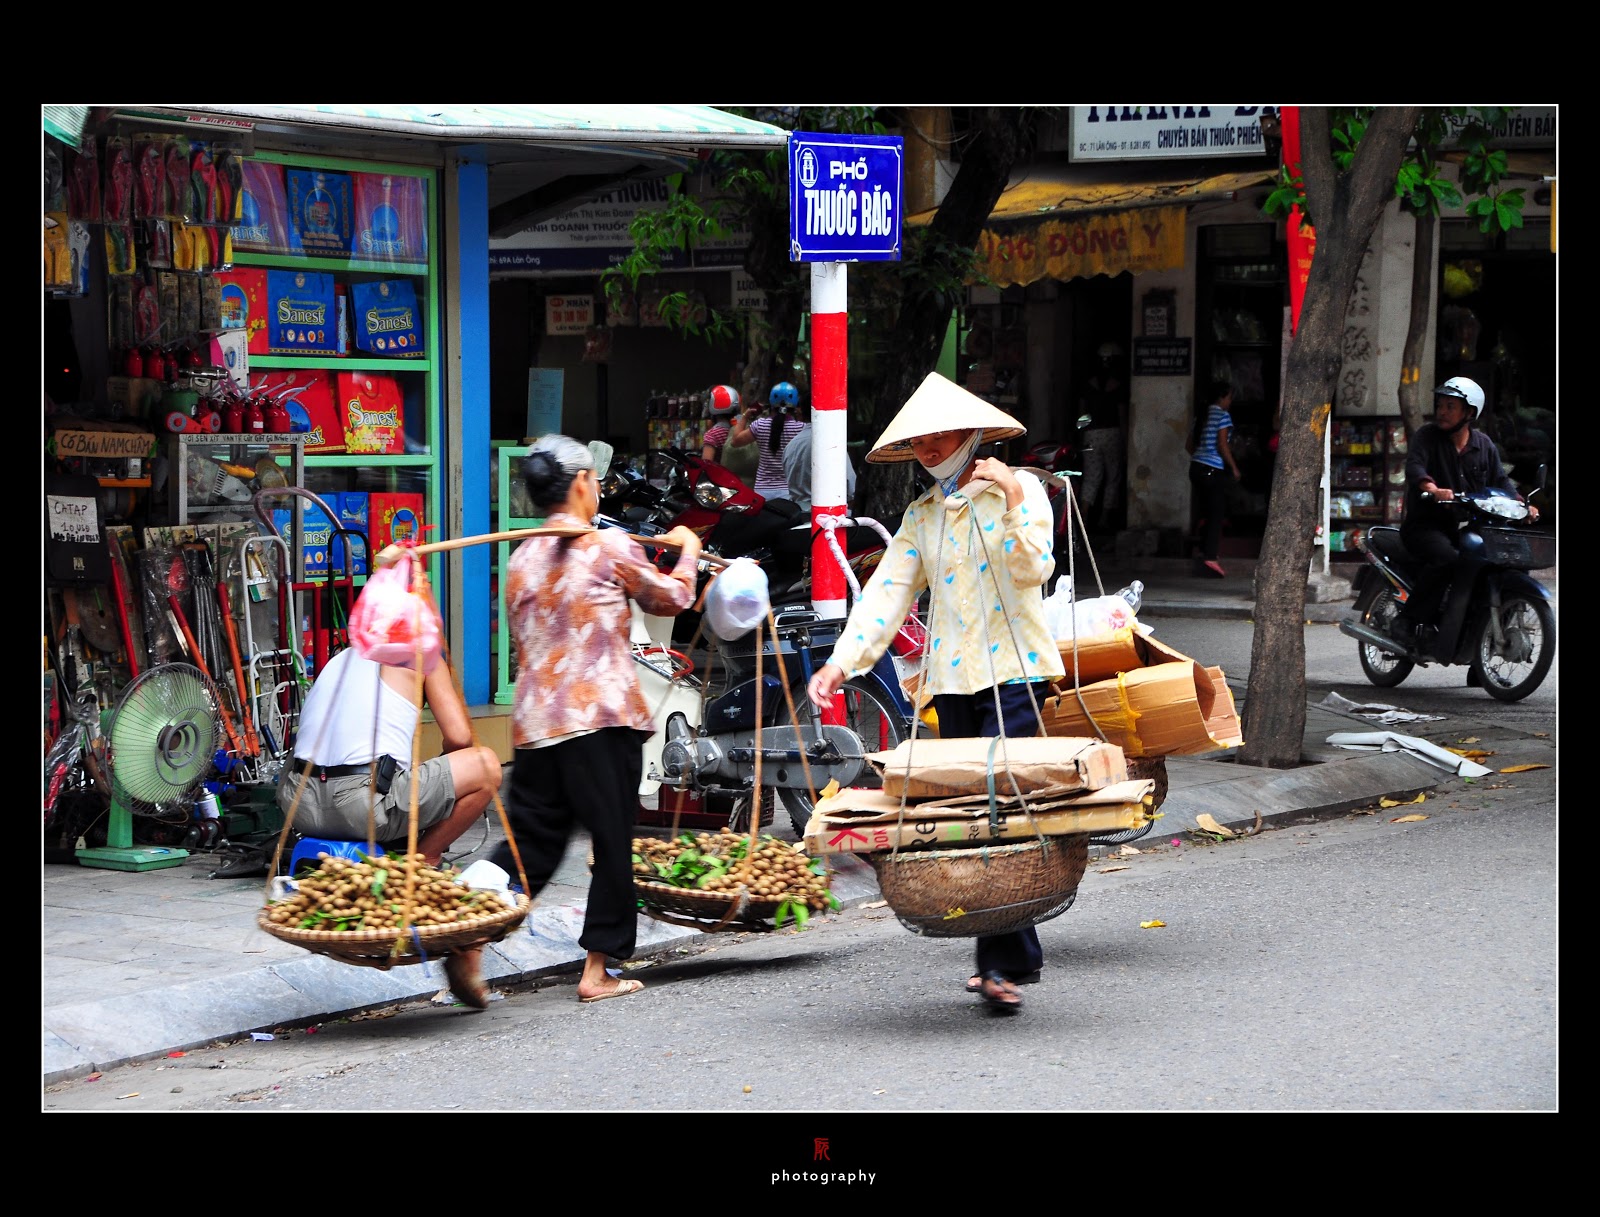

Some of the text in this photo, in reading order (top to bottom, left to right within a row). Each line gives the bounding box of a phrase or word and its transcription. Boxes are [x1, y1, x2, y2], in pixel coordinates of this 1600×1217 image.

[1158, 126, 1189, 149] CHUYÊN
[1190, 125, 1207, 148] BÁN
[1209, 122, 1235, 146] THUỐC
[830, 157, 868, 181] PHỐ
[581, 209, 594, 219] Thị
[595, 209, 611, 218] Kim
[804, 183, 893, 236] THUỐC BẮC
[551, 223, 589, 232] DOANH
[593, 220, 628, 231] THUỐC
[361, 229, 405, 256] Sanest
[1048, 226, 1127, 258] ĐÔNG
[1143, 223, 1163, 249] Y
[499, 256, 512, 265] 69A
[526, 253, 541, 266] Ông
[279, 298, 325, 325] Sanest
[738, 299, 759, 307] XEM
[367, 310, 413, 333] Sanest
[349, 400, 398, 428] Sanest
[76, 434, 98, 454] BÁN
[304, 429, 325, 445] est
[733, 645, 770, 653] HONA
